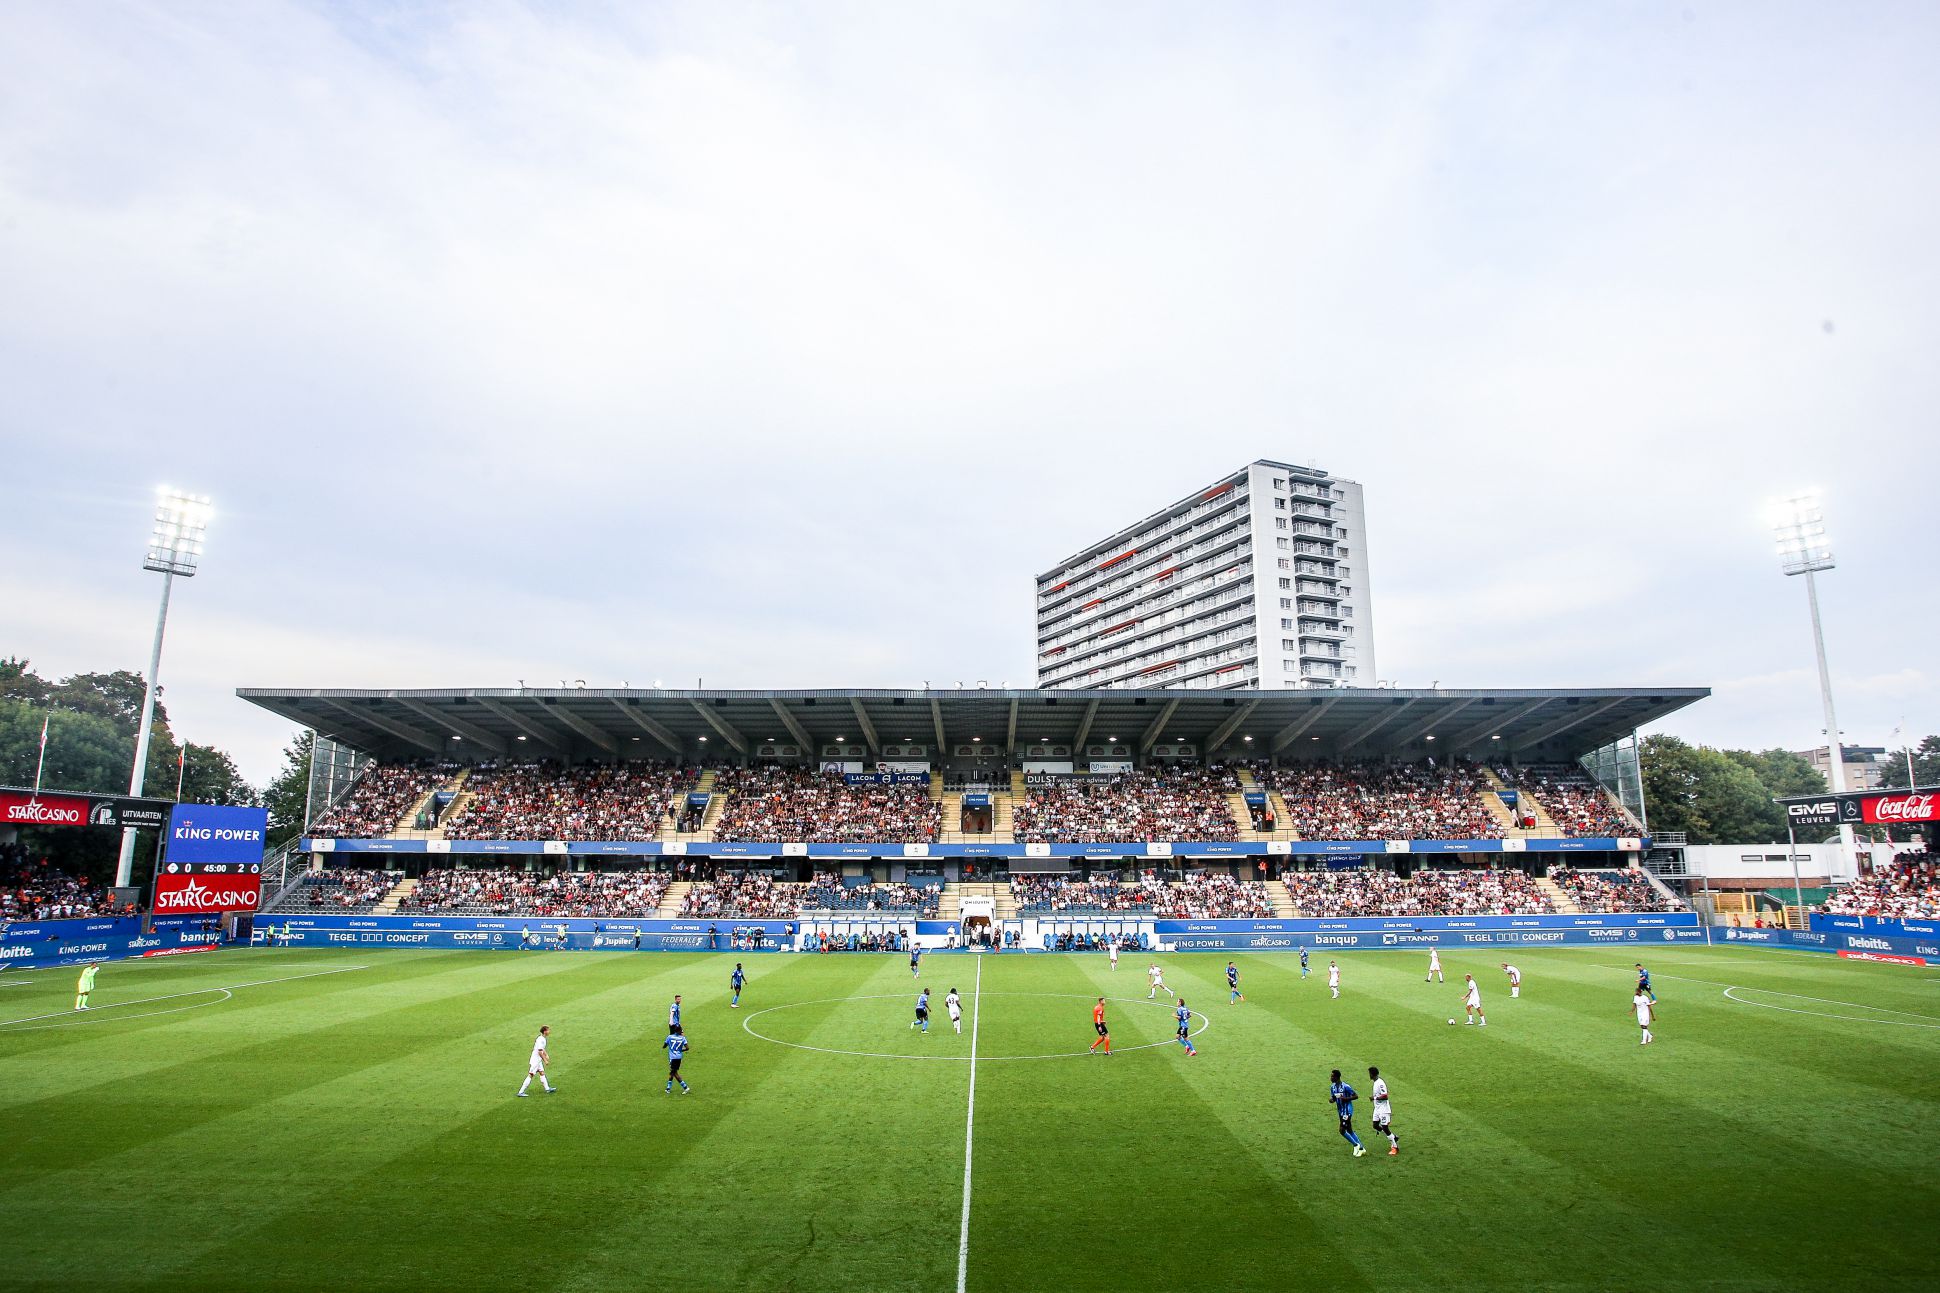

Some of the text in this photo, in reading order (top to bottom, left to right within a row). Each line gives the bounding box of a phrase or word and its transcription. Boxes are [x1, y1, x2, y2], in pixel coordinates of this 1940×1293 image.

[1788, 802, 1836, 815] GMS
[122, 810, 162, 819] UITVAARTEN
[176, 827, 259, 841] KING POWER
[185, 864, 244, 873] 0 45:00 2
[604, 937, 634, 946] Jupiler
[1315, 934, 1358, 945] banqup
[1522, 933, 1564, 941] CONCEPT
[1848, 937, 1892, 950] Deloitte.
[59, 944, 107, 955] KING POWER
[1916, 946, 1938, 955] KING
[671, 1040, 682, 1050] 77
